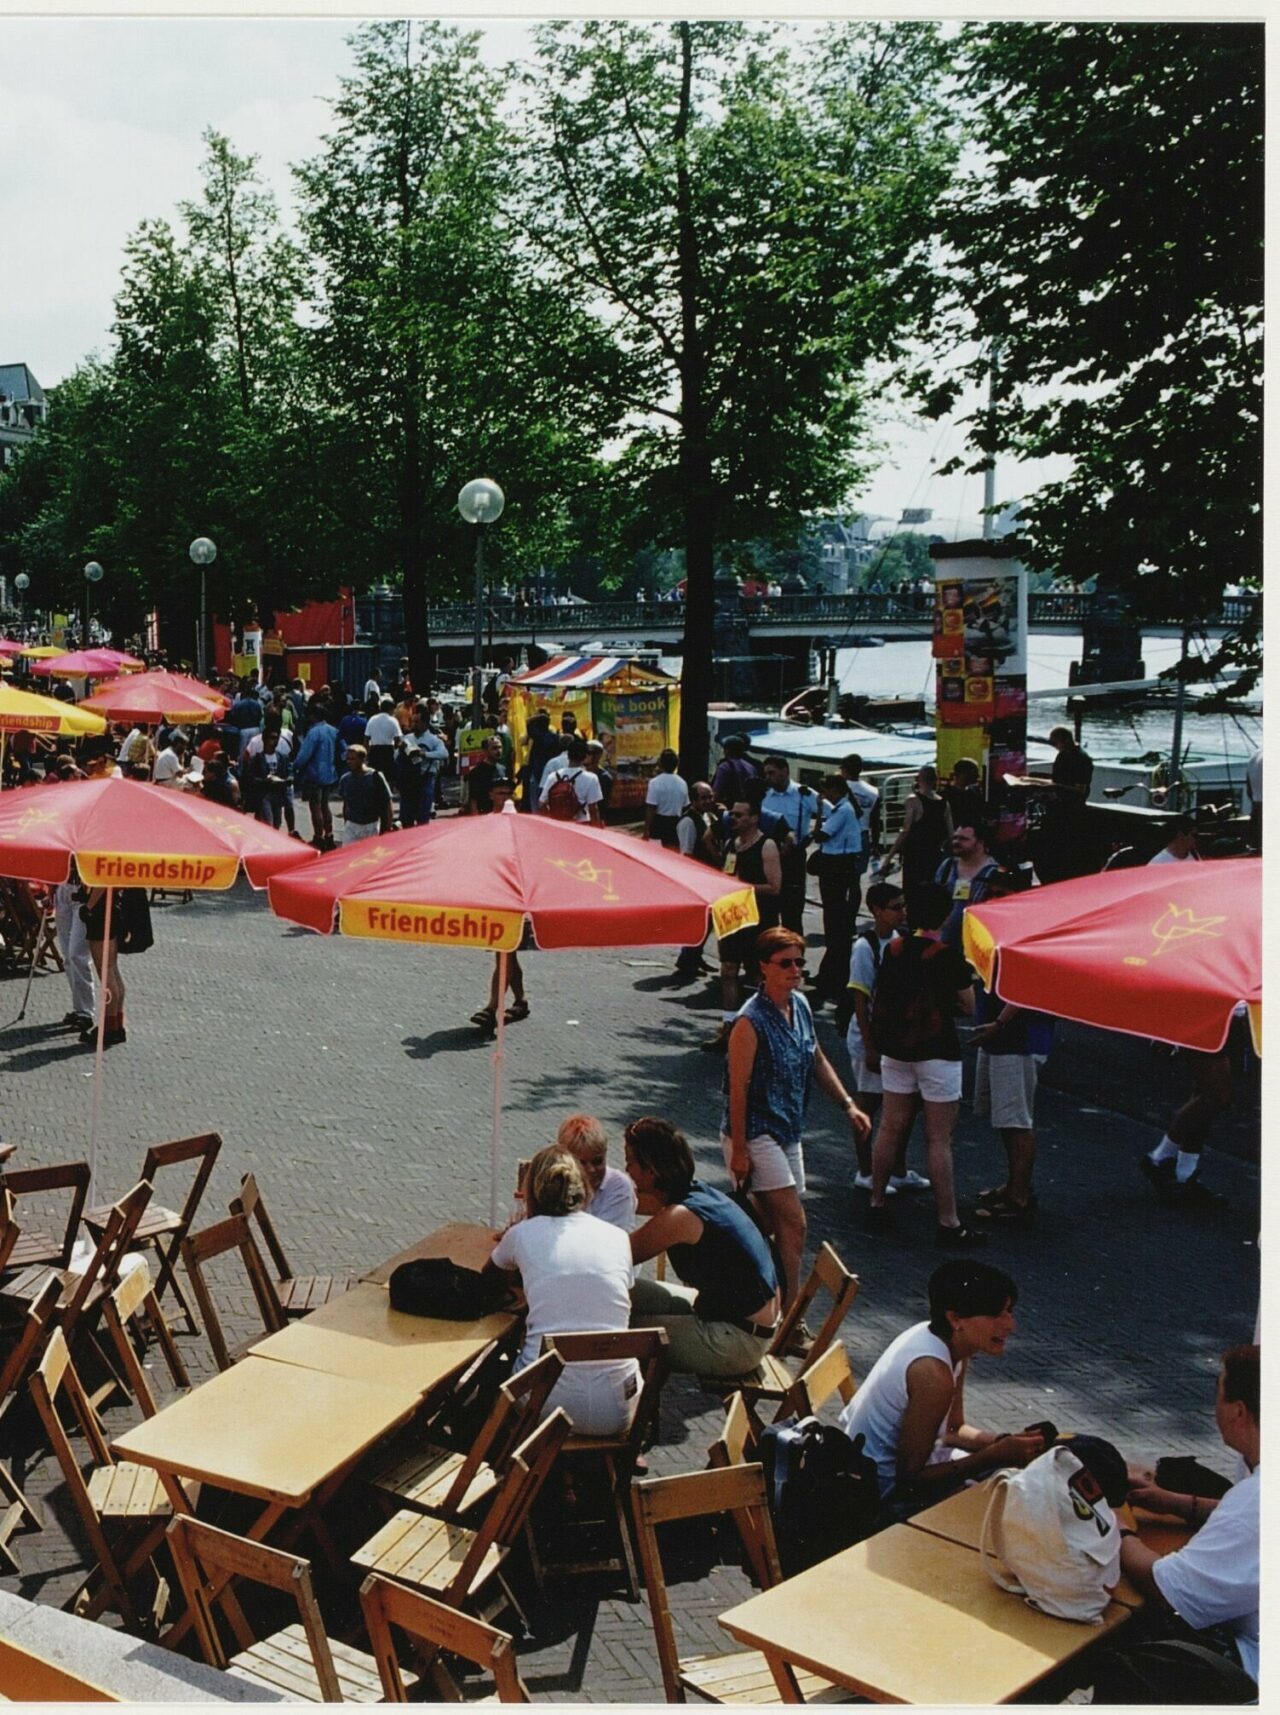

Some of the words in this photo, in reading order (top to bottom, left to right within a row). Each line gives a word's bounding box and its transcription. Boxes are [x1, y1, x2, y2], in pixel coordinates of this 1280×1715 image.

[629, 697, 666, 713] book
[95, 855, 216, 884] Friendship
[368, 907, 505, 946] Friendship
